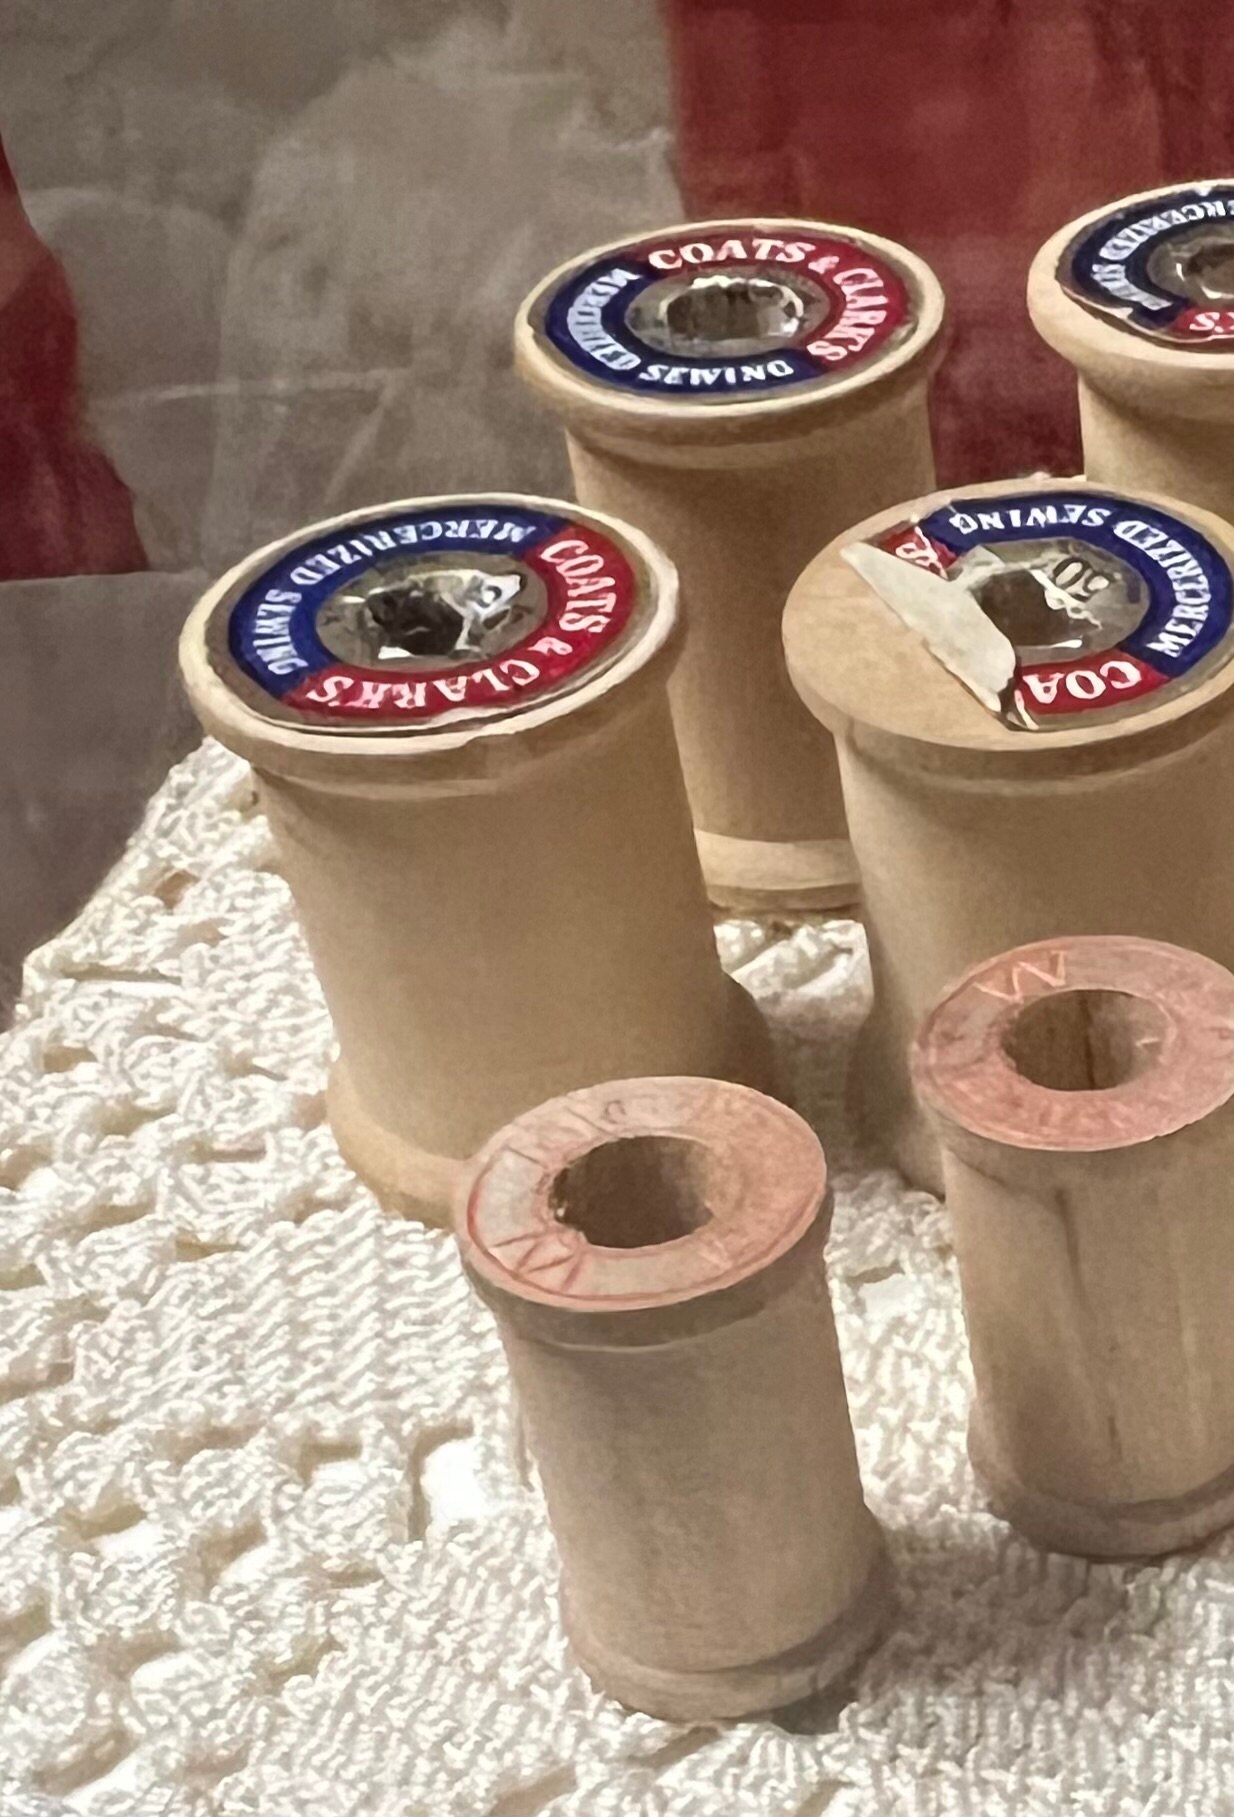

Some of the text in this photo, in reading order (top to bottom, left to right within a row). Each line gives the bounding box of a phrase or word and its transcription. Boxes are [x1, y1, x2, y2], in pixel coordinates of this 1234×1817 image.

[648, 238, 817, 270] COATS
[808, 255, 839, 273] &
[252, 518, 536, 676] MERCERIZED SEWING
[305, 539, 617, 710] COATS & CLARK'S
[949, 503, 1213, 659] MERCERIZED SEWING
